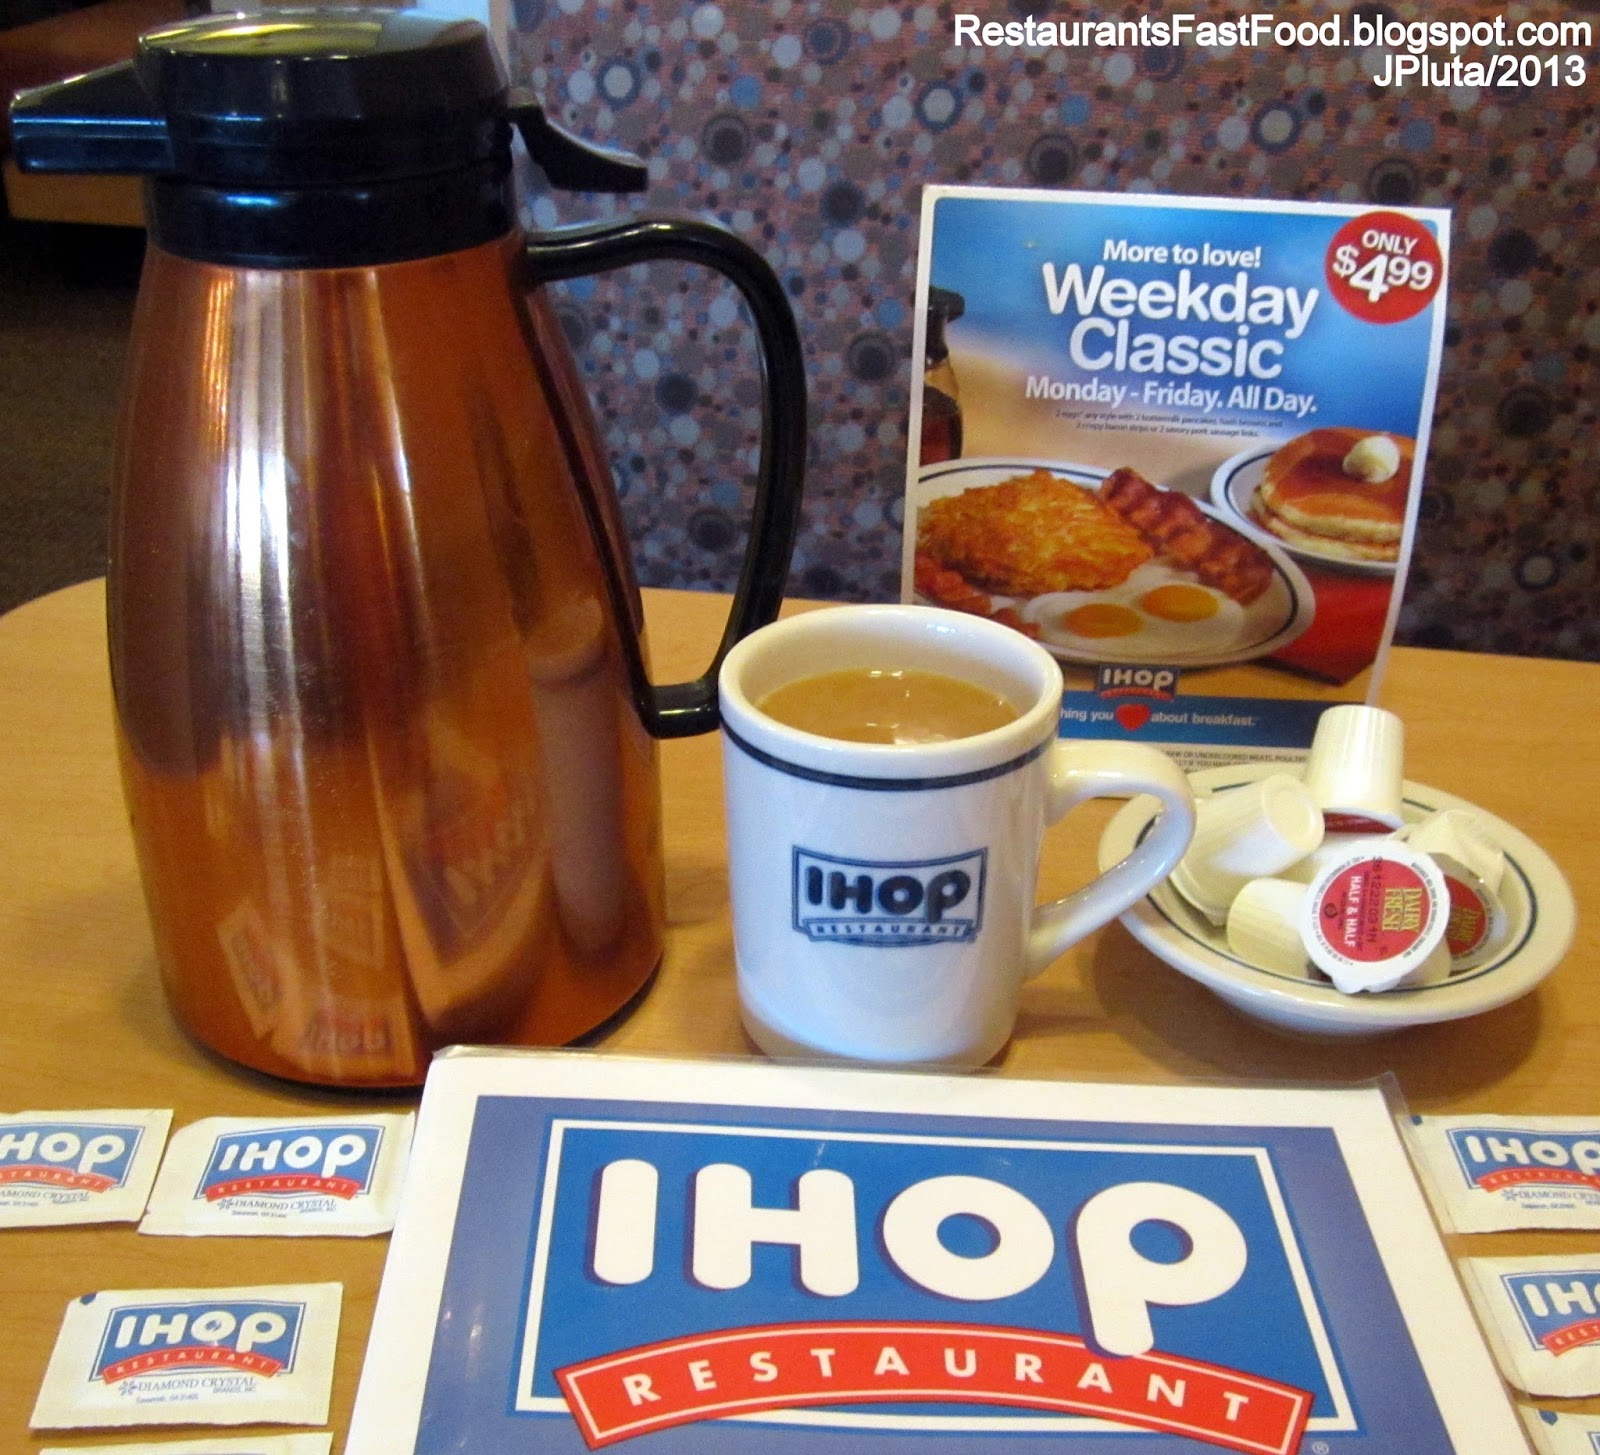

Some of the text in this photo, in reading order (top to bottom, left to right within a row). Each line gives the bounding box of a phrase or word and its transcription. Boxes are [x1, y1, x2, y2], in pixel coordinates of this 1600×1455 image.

[1102, 239, 1262, 268] More to love!
[1361, 230, 1419, 256] ONLY
[1042, 262, 1320, 340] Weekday
[1069, 317, 1285, 379] Classic
[1025, 375, 1127, 409] Monday
[1143, 380, 1223, 414] Friday.
[1228, 384, 1261, 409] All
[1264, 387, 1318, 418] Day.
[1102, 668, 1175, 692] IHOP
[1060, 706, 1088, 723] hing
[1091, 710, 1115, 723] you
[1151, 712, 1189, 724] about
[805, 865, 972, 924] IHOP
[1348, 875, 1363, 905] HALF
[1346, 906, 1359, 916] &
[1381, 888, 1404, 932] FRESH
[1400, 888, 1422, 933] DAIRY
[816, 925, 961, 935] RESTAURANT
[1343, 918, 1358, 948] HALF
[0, 1131, 126, 1174] HOP
[218, 1134, 367, 1179] IHOP
[232, 1198, 338, 1211] DIAMOND CRYSTAL
[593, 1158, 1248, 1357] IHOP
[1522, 1281, 1600, 1317] IH
[115, 1310, 287, 1353] IHOP
[116, 1350, 268, 1374] RESTAURANT
[137, 1376, 257, 1392] DIAMOND CRYSTAL
[622, 1346, 1250, 1423] RESTAURANT
